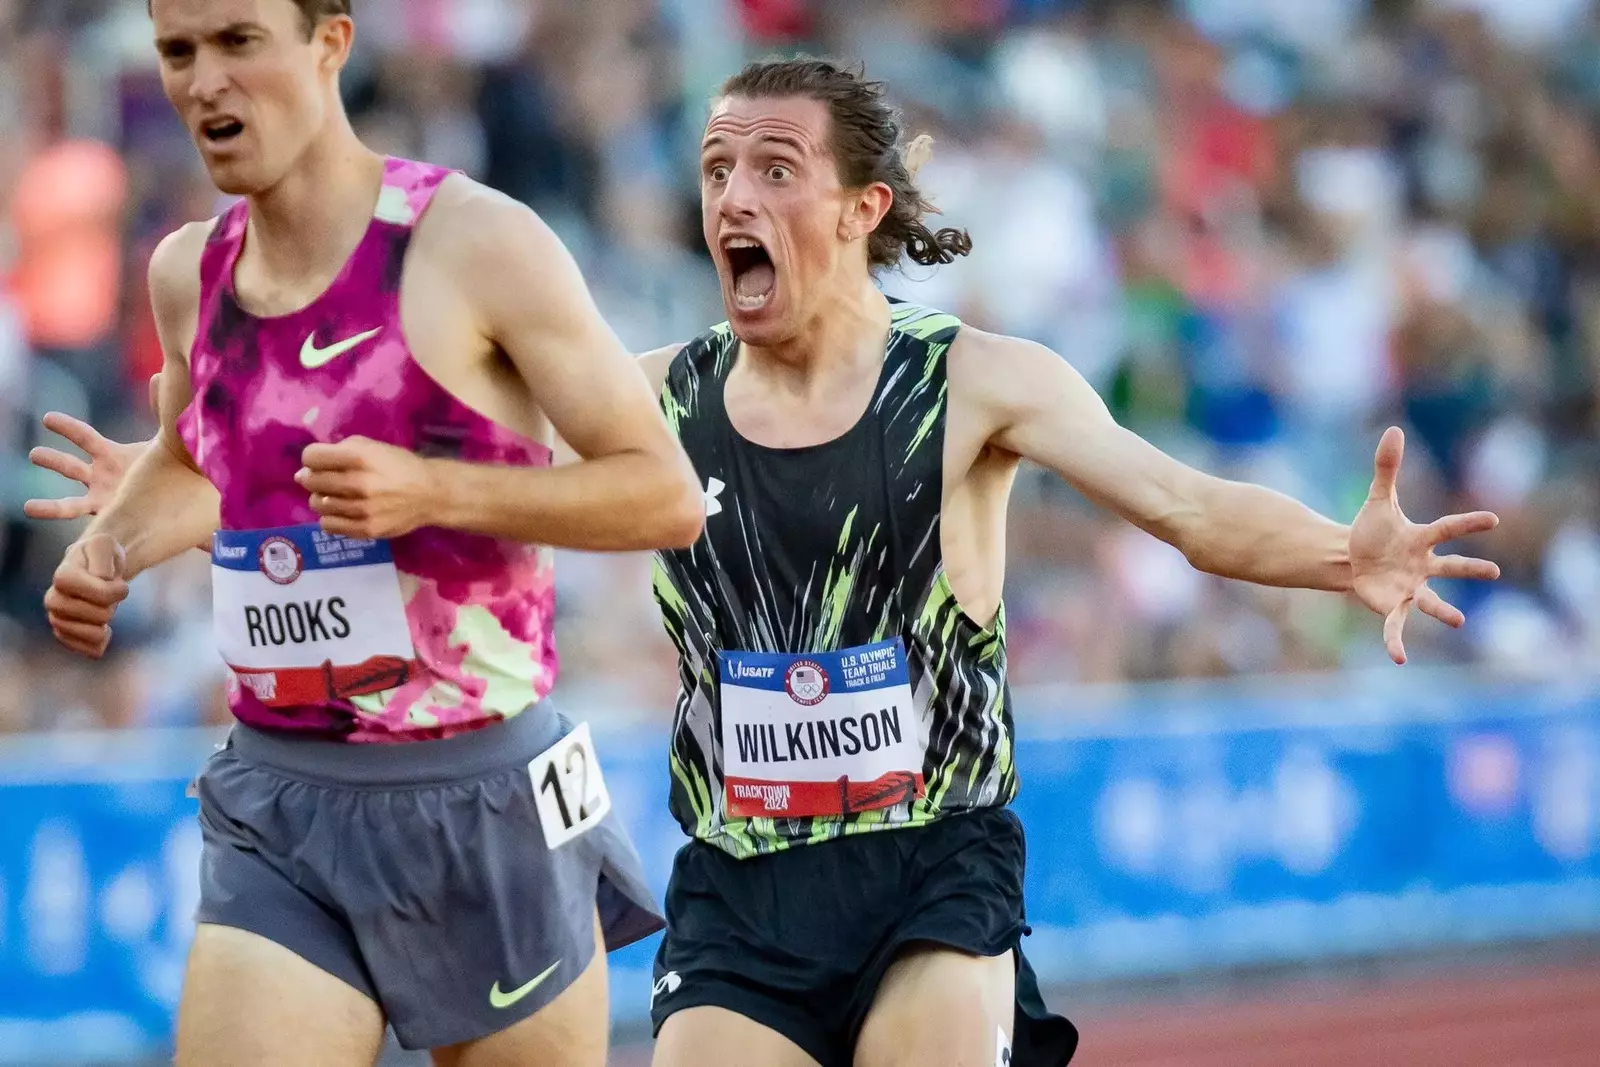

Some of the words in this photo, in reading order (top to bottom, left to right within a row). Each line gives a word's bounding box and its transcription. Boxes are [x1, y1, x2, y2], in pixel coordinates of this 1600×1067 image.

[244, 596, 351, 647] ROOKS
[841, 655, 858, 668] U.S.
[860, 646, 895, 664] OLYMPIC
[742, 666, 775, 678] USATF
[843, 665, 867, 679] TEAM
[868, 658, 896, 674] TRIALS
[845, 677, 865, 688] TRACK
[870, 672, 886, 684] FIELD
[735, 705, 902, 763] WILKINSON
[541, 742, 602, 830] 12
[733, 784, 790, 801] TRACKTOWN
[764, 797, 788, 810] 2024
